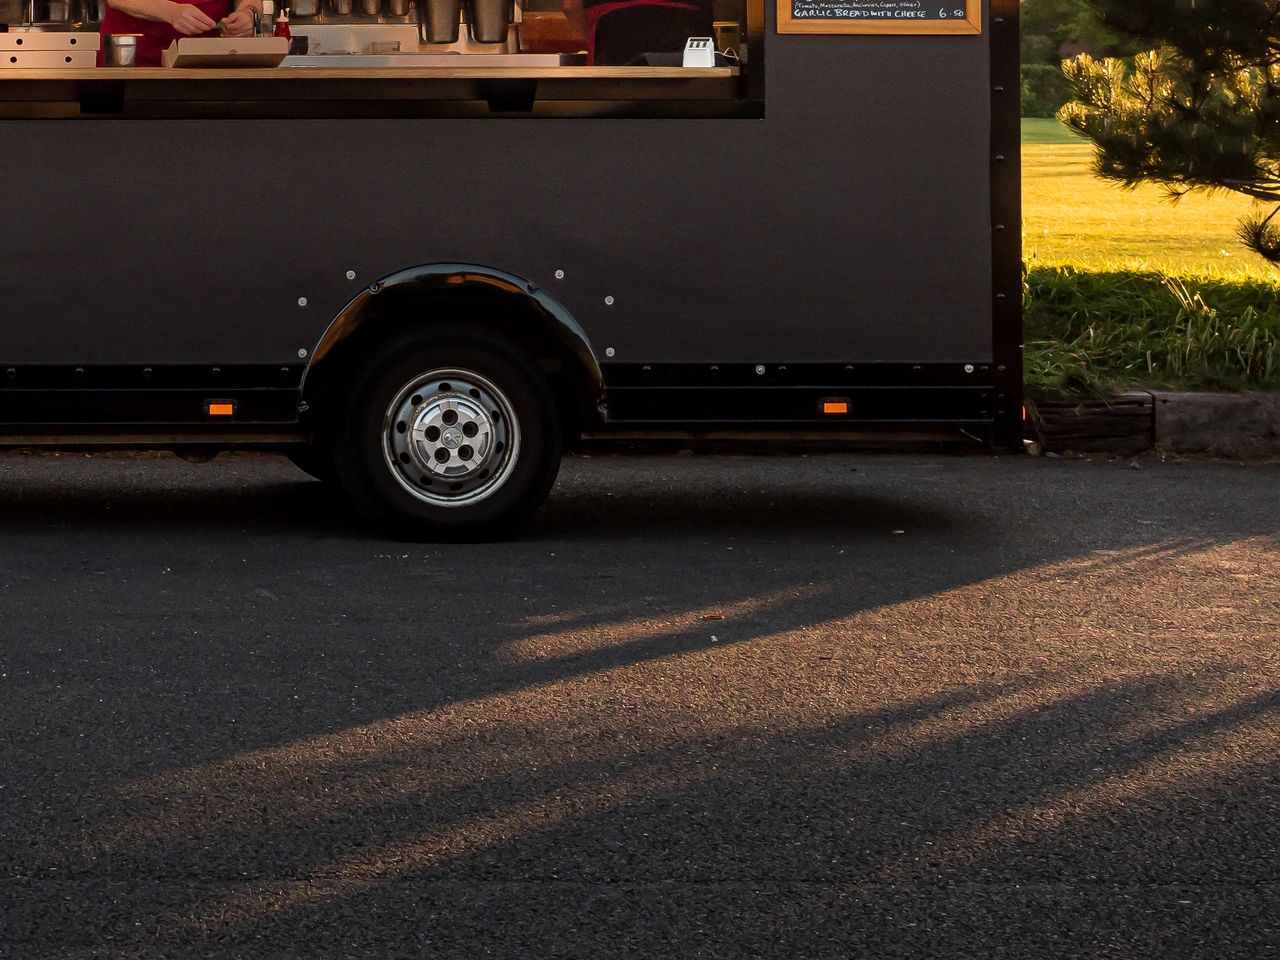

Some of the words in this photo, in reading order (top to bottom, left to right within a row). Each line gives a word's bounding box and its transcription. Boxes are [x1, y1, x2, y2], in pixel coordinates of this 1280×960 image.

[793, 8, 833, 17] GARLIC
[834, 8, 870, 17] BREAD
[894, 10, 927, 18] CHEESE
[939, 8, 964, 18] 6.50
